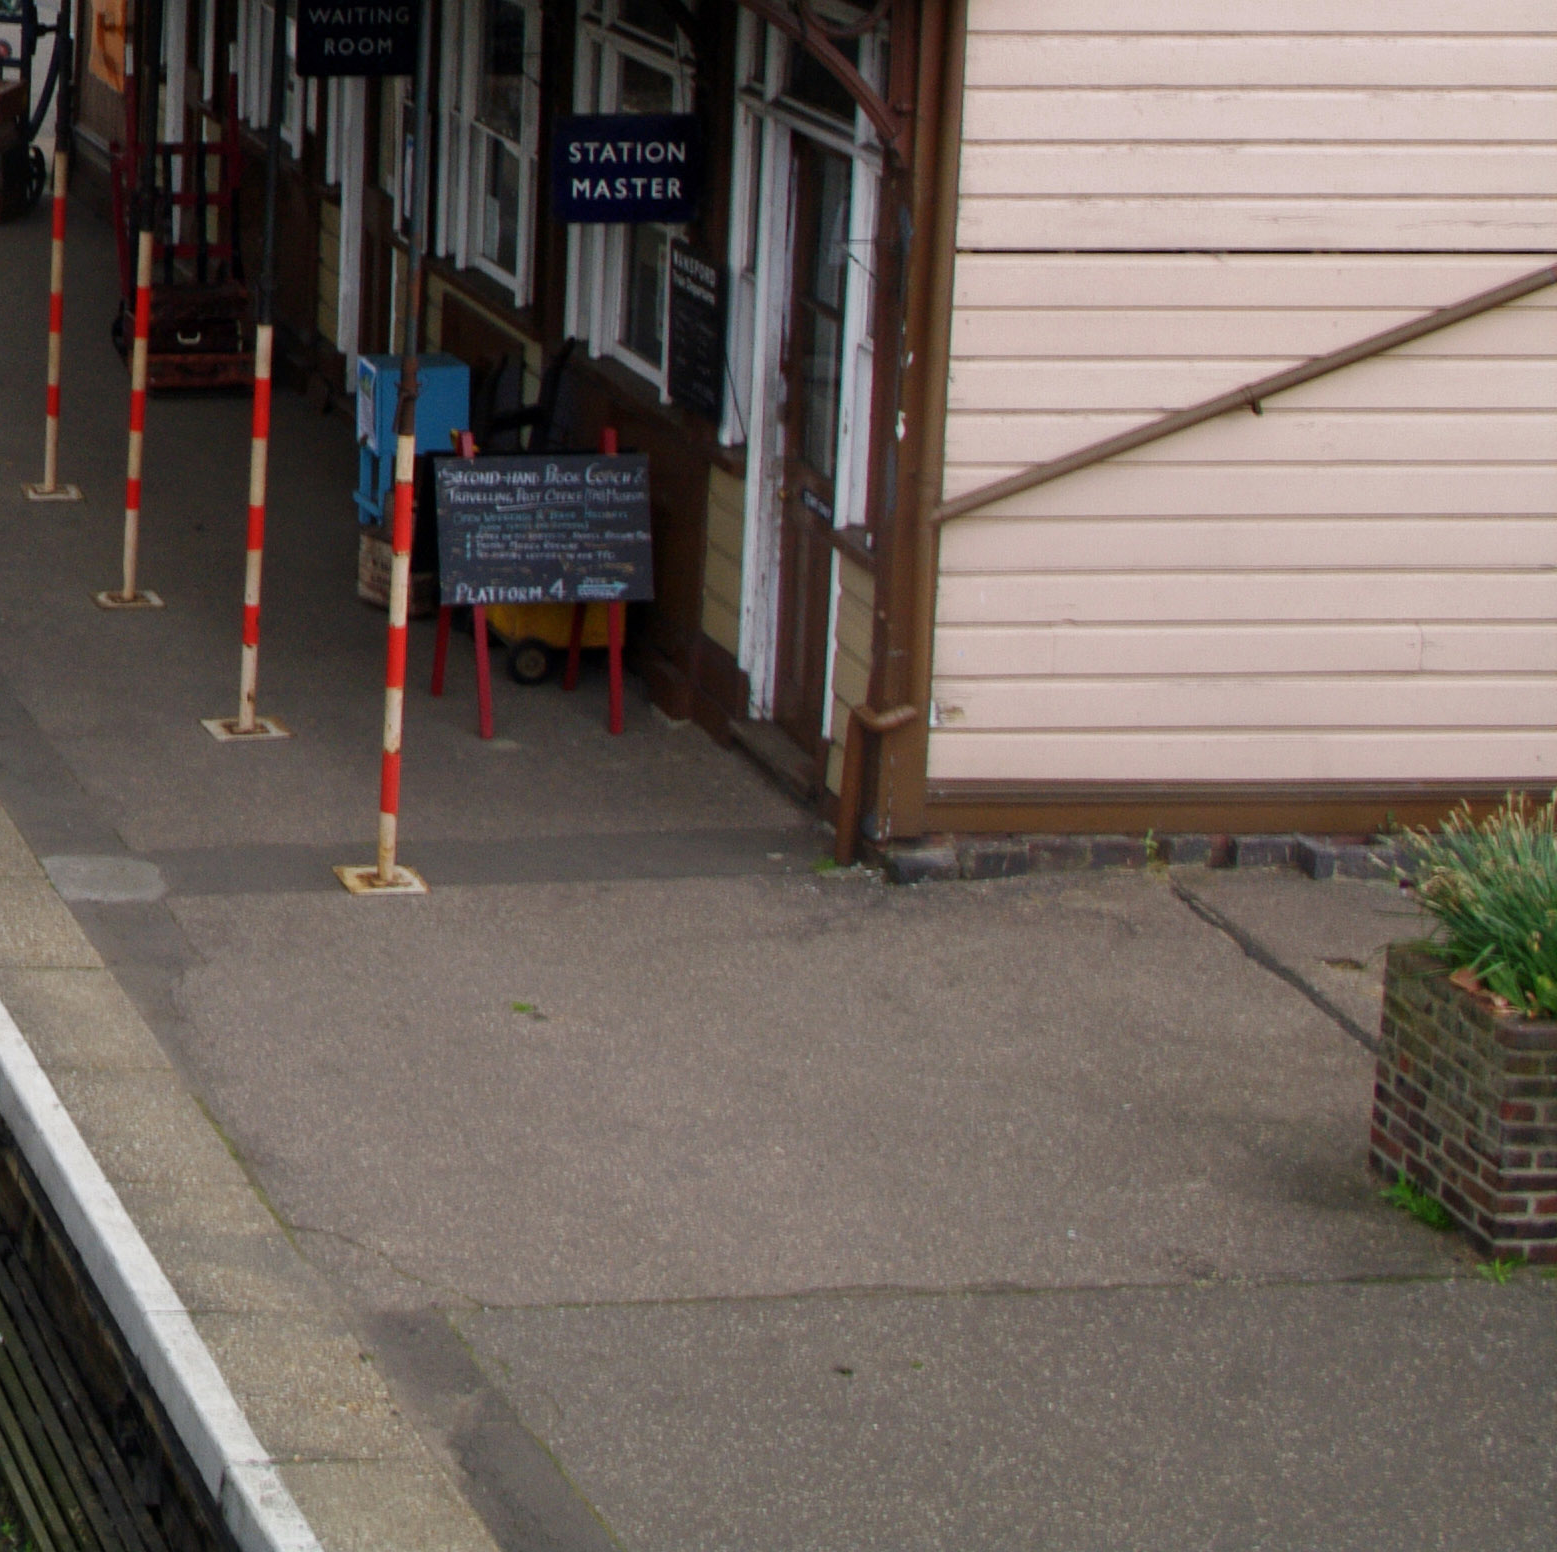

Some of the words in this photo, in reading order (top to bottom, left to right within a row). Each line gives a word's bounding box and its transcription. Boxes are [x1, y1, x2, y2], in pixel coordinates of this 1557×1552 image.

[308, 5, 411, 26] WAITING
[324, 38, 394, 56] ROOM
[568, 141, 687, 165] STATION
[571, 176, 683, 200] MASTER
[549, 578, 567, 600] 4
